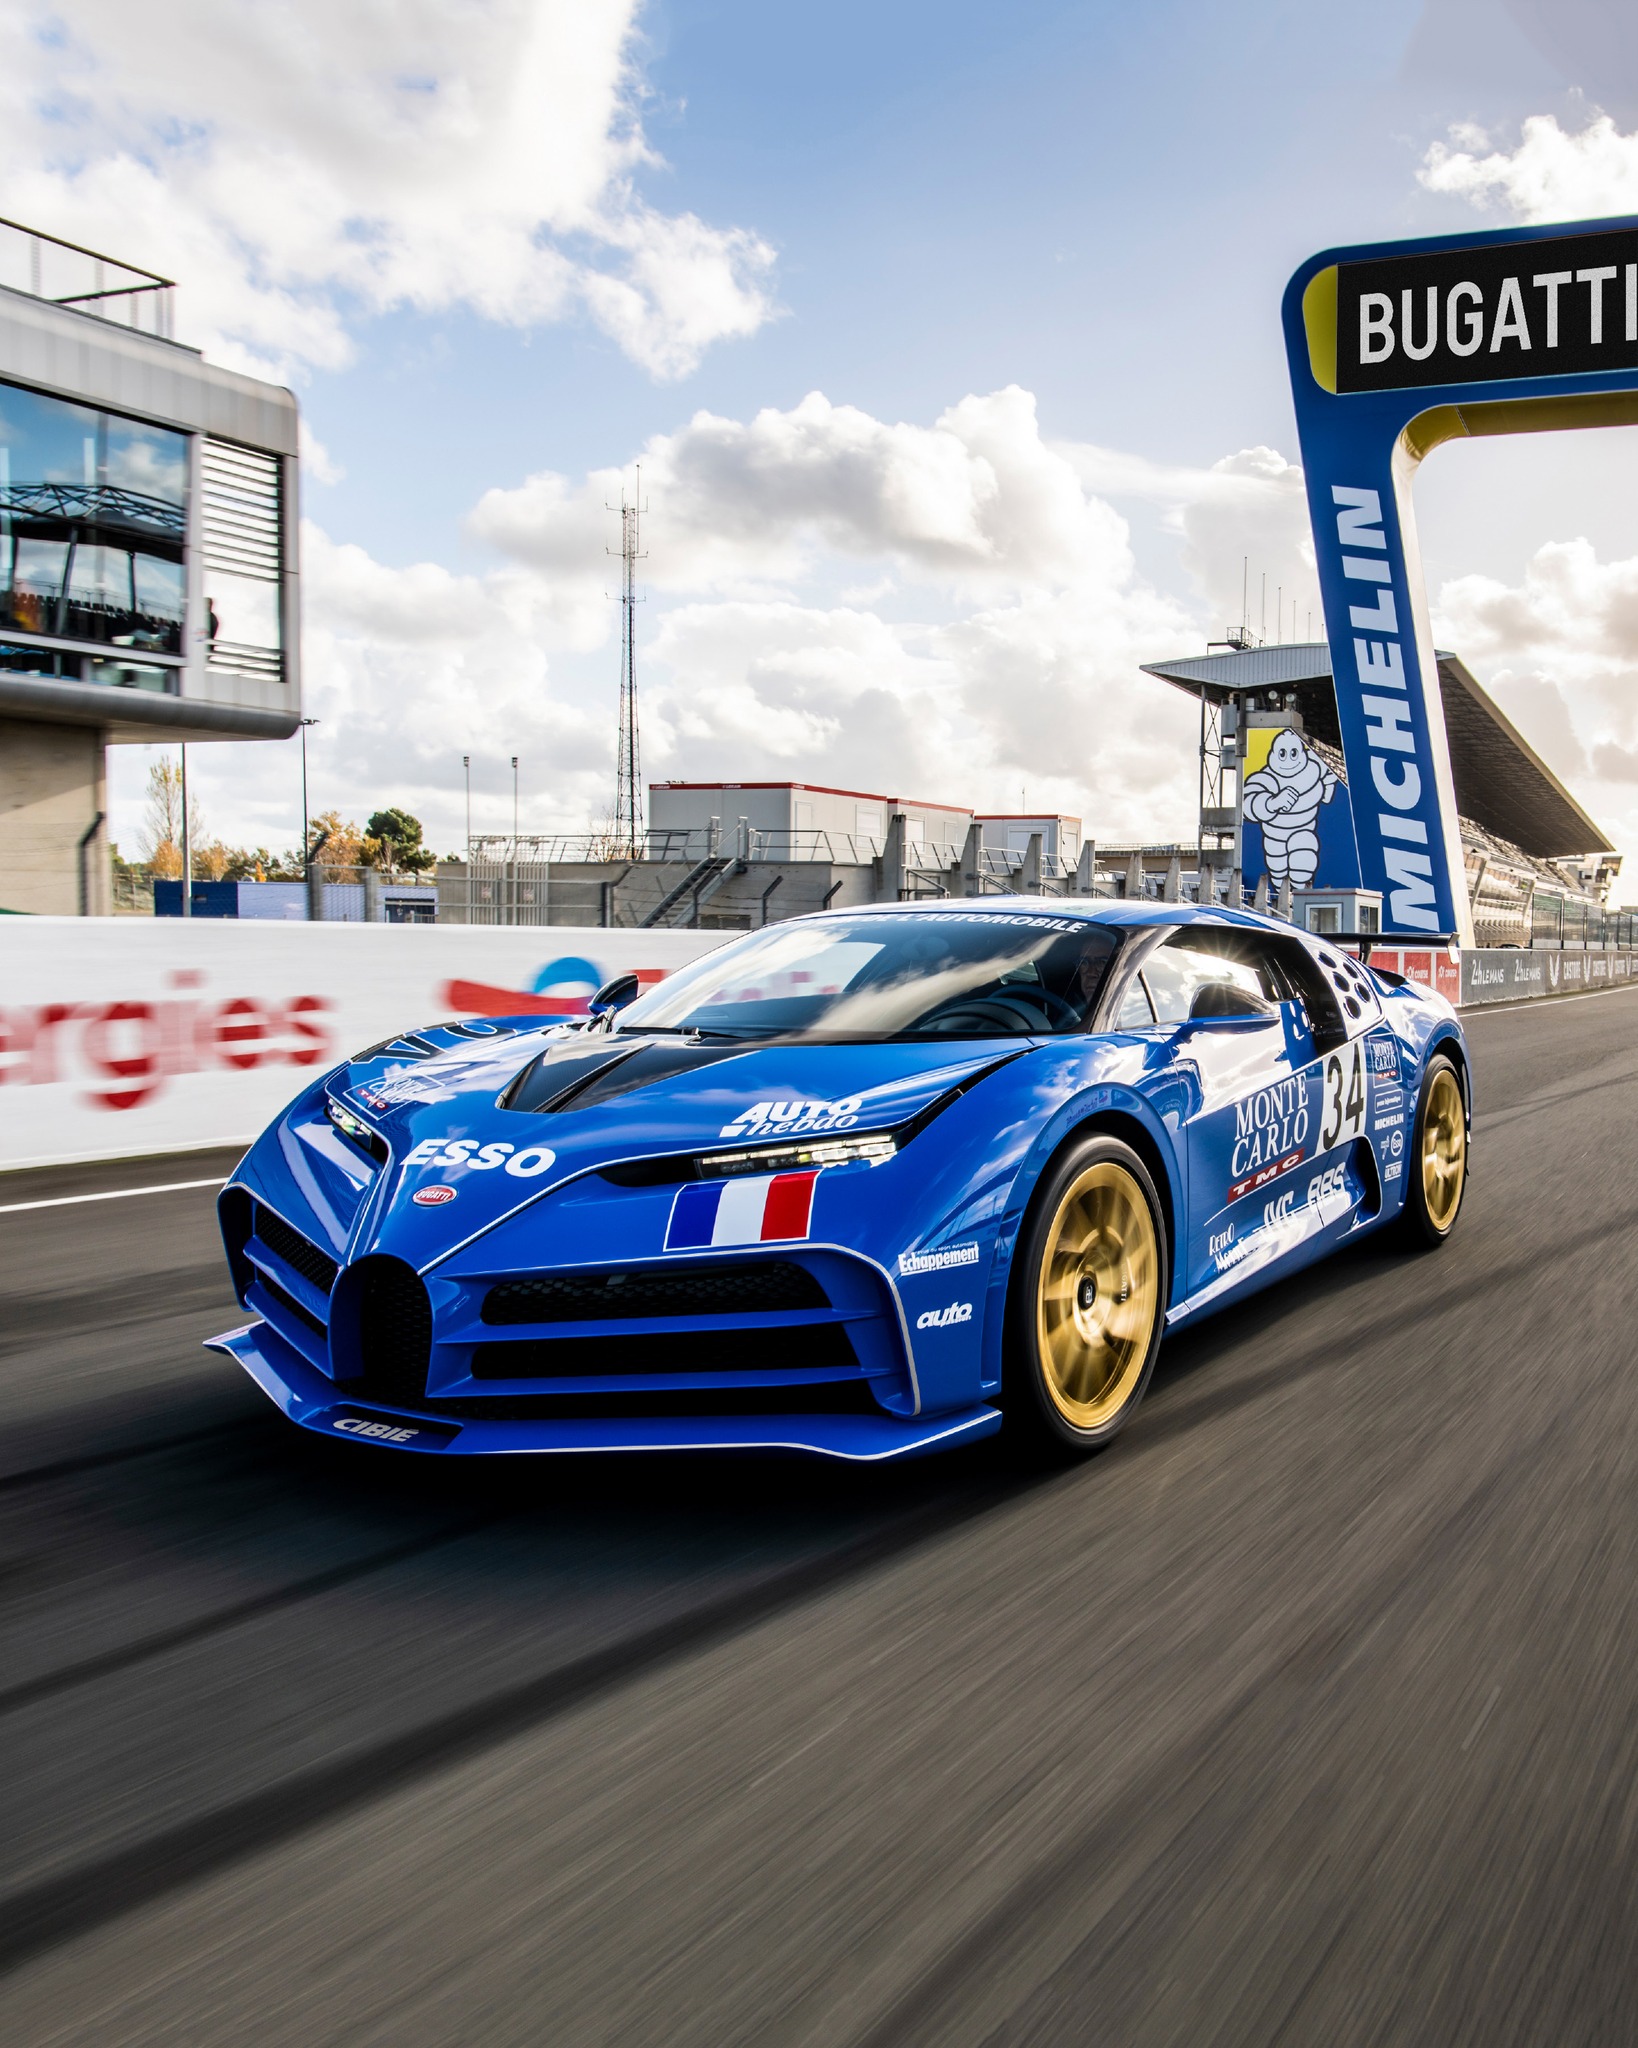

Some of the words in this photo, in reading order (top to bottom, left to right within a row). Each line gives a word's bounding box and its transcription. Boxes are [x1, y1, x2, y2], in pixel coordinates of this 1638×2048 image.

[1359, 263, 1638, 364] BUGATTI
[1331, 485, 1440, 932] MICHELIN
[896, 914, 1088, 933] L'AUTOMOBILE
[731, 1099, 862, 1124] AUTO
[1234, 1072, 1309, 1141] MONTE
[1322, 1042, 1364, 1151] 34
[746, 1115, 859, 1136] hebdo
[1375, 1113, 1403, 1131] MICHELIN
[400, 1139, 556, 1177] ESSO
[1231, 1108, 1309, 1177] CARLO
[416, 1190, 451, 1200] BUGATTI
[1209, 1222, 1235, 1257] RETRO
[898, 1243, 979, 1271] Echappement
[917, 1301, 972, 1329] auto
